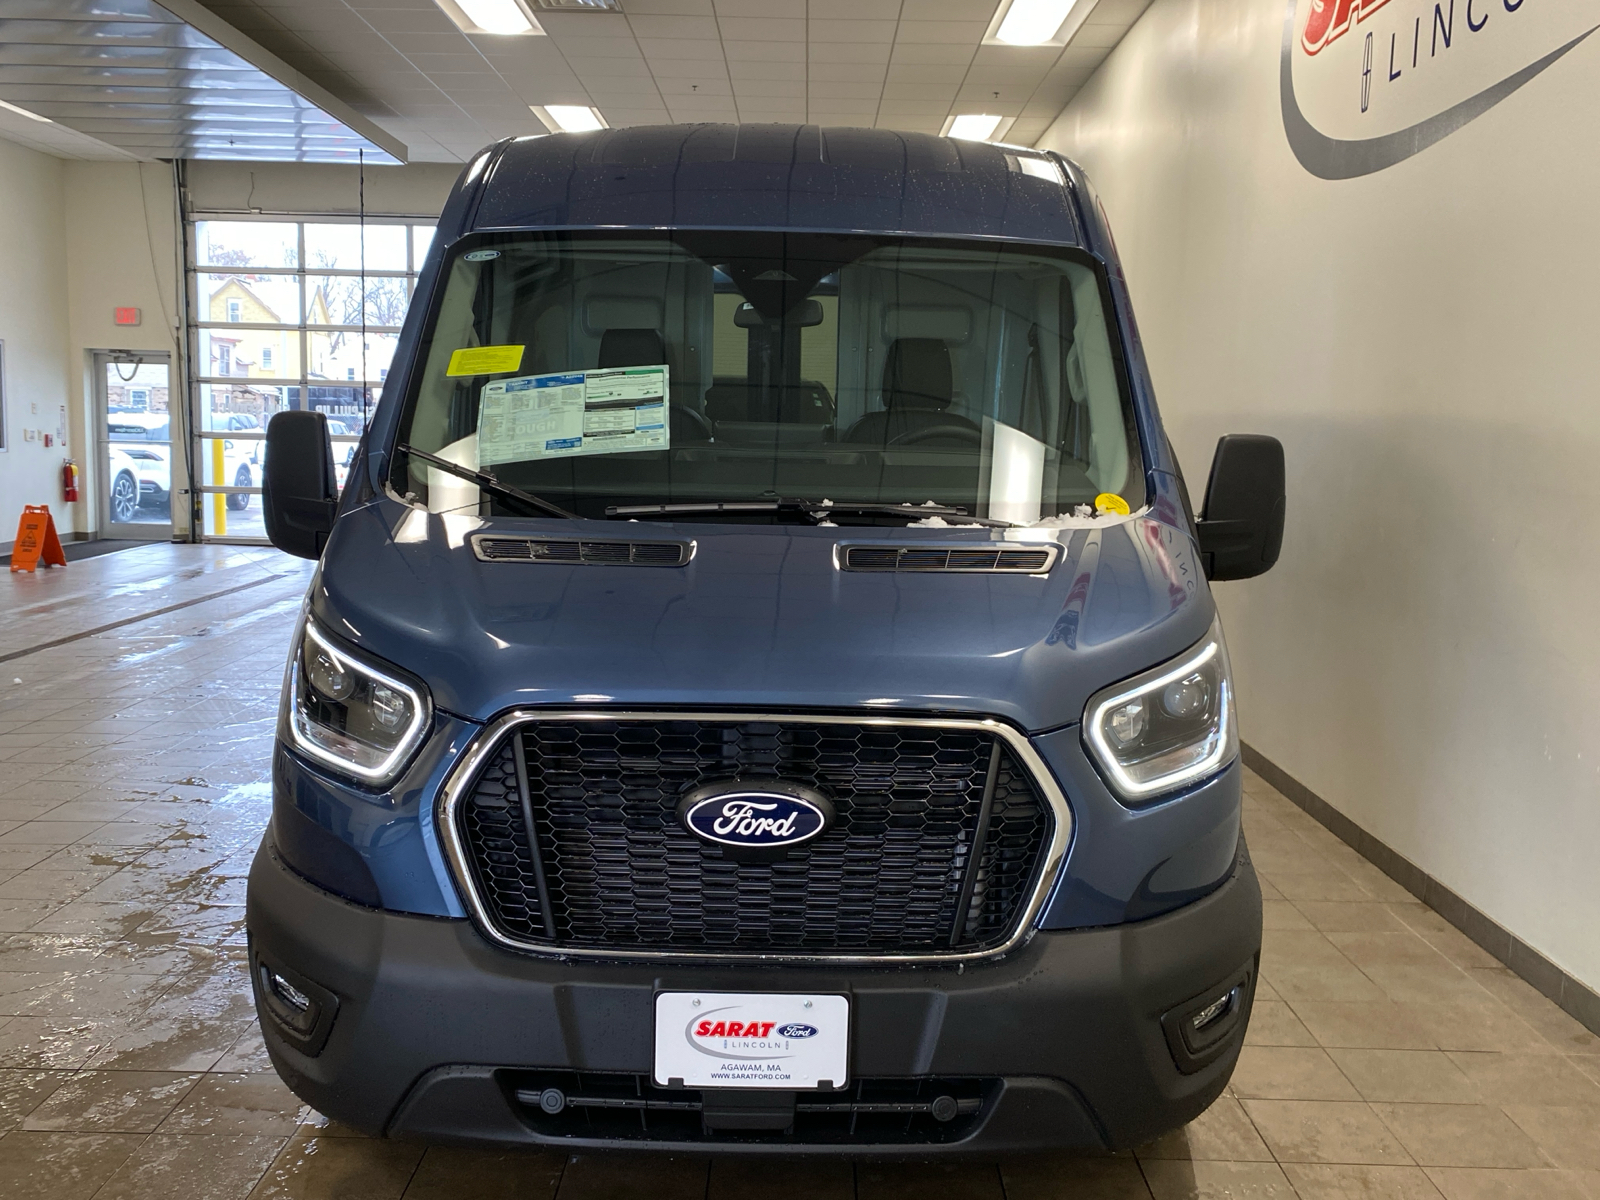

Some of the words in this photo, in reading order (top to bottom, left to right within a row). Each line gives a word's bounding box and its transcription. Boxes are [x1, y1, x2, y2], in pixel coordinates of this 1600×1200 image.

[1388, 0, 1525, 82] LINC
[712, 800, 799, 837] Ford
[694, 1019, 777, 1039] SARAT
[783, 1023, 812, 1037] Ford
[731, 1041, 781, 1049] LINCOLN
[720, 1063, 765, 1072] AGAWAM,
[766, 1064, 782, 1072] MA
[710, 1072, 791, 1080] WWW.SARATFORD.COM
